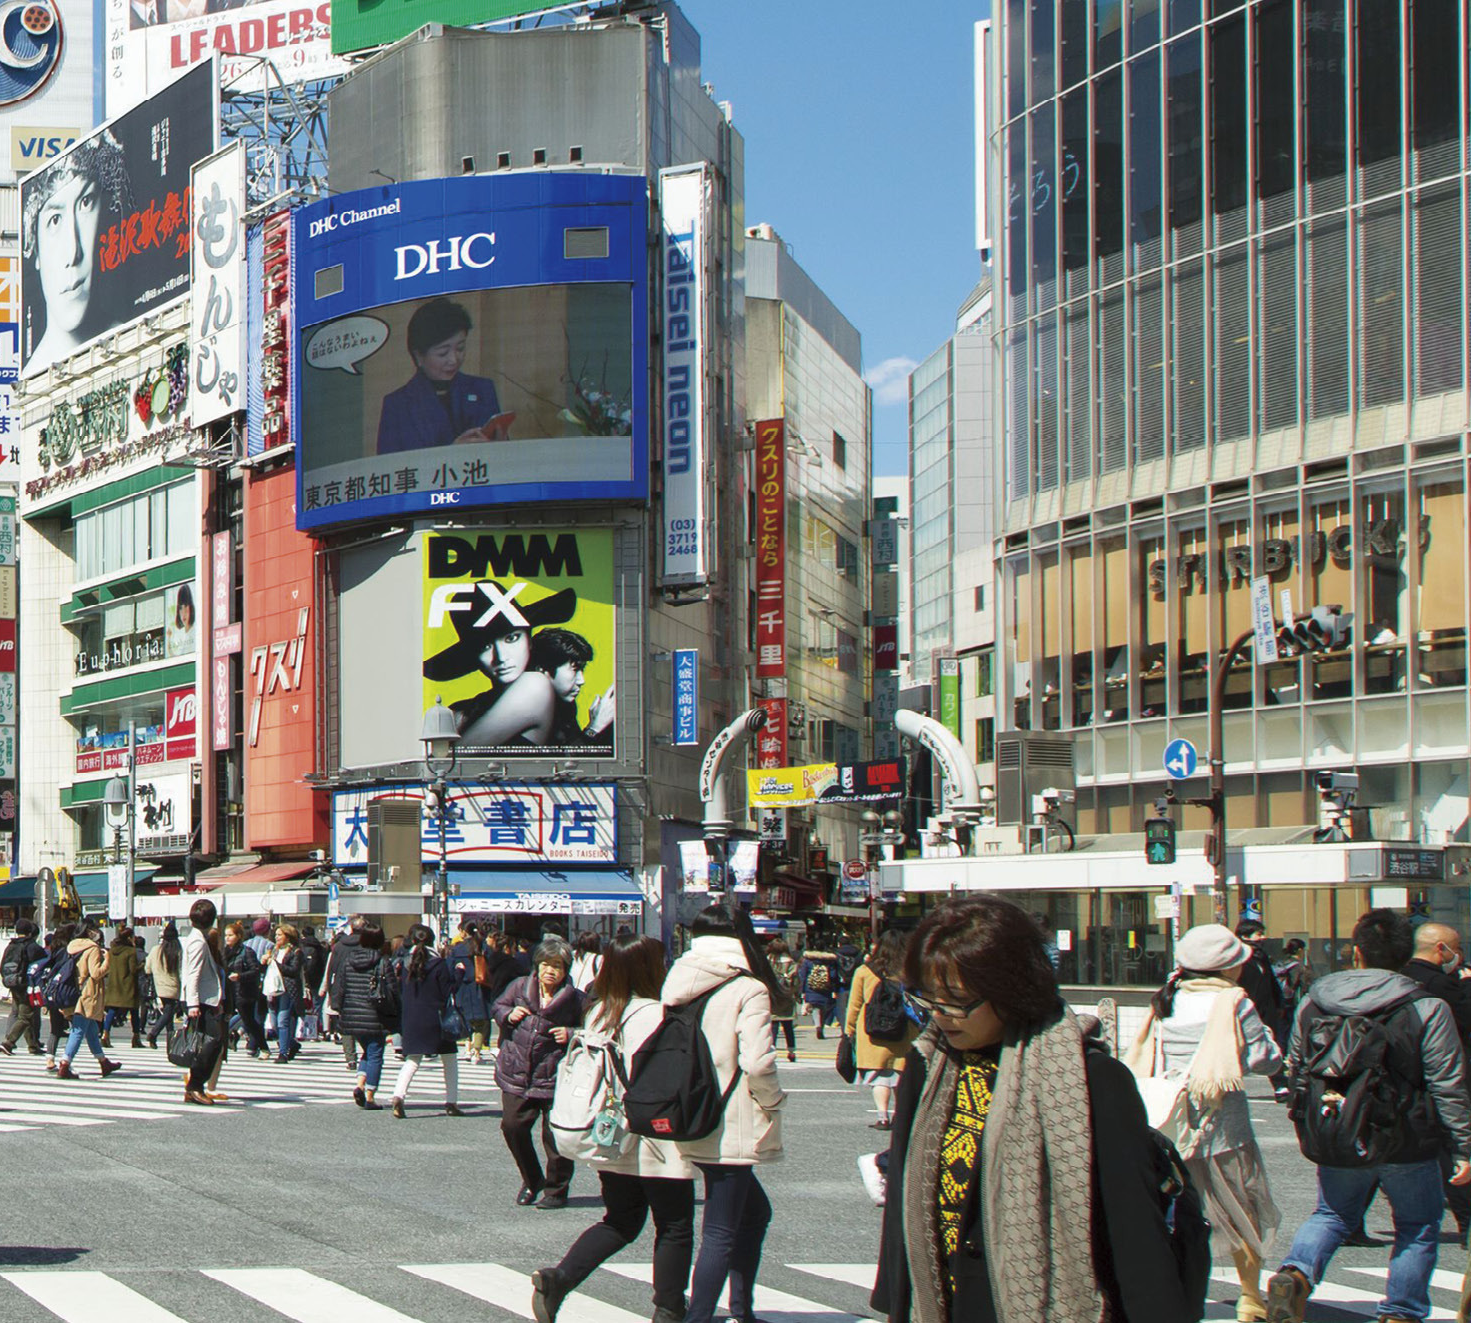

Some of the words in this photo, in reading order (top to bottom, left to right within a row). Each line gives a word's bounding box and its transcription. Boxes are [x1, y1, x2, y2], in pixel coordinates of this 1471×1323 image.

[170, 3, 331, 69] LEADERS
[309, 214, 338, 238] DHC
[340, 198, 401, 226] Channel
[394, 232, 496, 281] DHC
[197, 182, 239, 407] もんじゃ
[668, 220, 696, 353] Taisei
[668, 366, 691, 475] neon
[306, 467, 419, 511] 東京都知事
[432, 459, 489, 488] 小池
[431, 492, 460, 505] DHC
[761, 428, 780, 567] クスリのことなら
[668, 532, 697, 545] 3719
[670, 519, 696, 532] (03)
[428, 533, 583, 579] DMM
[668, 544, 697, 555] 2468
[427, 582, 530, 628] FX
[759, 580, 782, 665] 三千里
[78, 634, 161, 673] Euphoria
[248, 606, 310, 748] クスリ
[678, 655, 693, 740] 大盛堂商事ビル
[169, 694, 196, 730] JTB
[345, 799, 598, 846] 大堂書店
[549, 848, 573, 858] BOOKS
[576, 847, 609, 858] TAISEIDO
[619, 902, 640, 914] 発売
